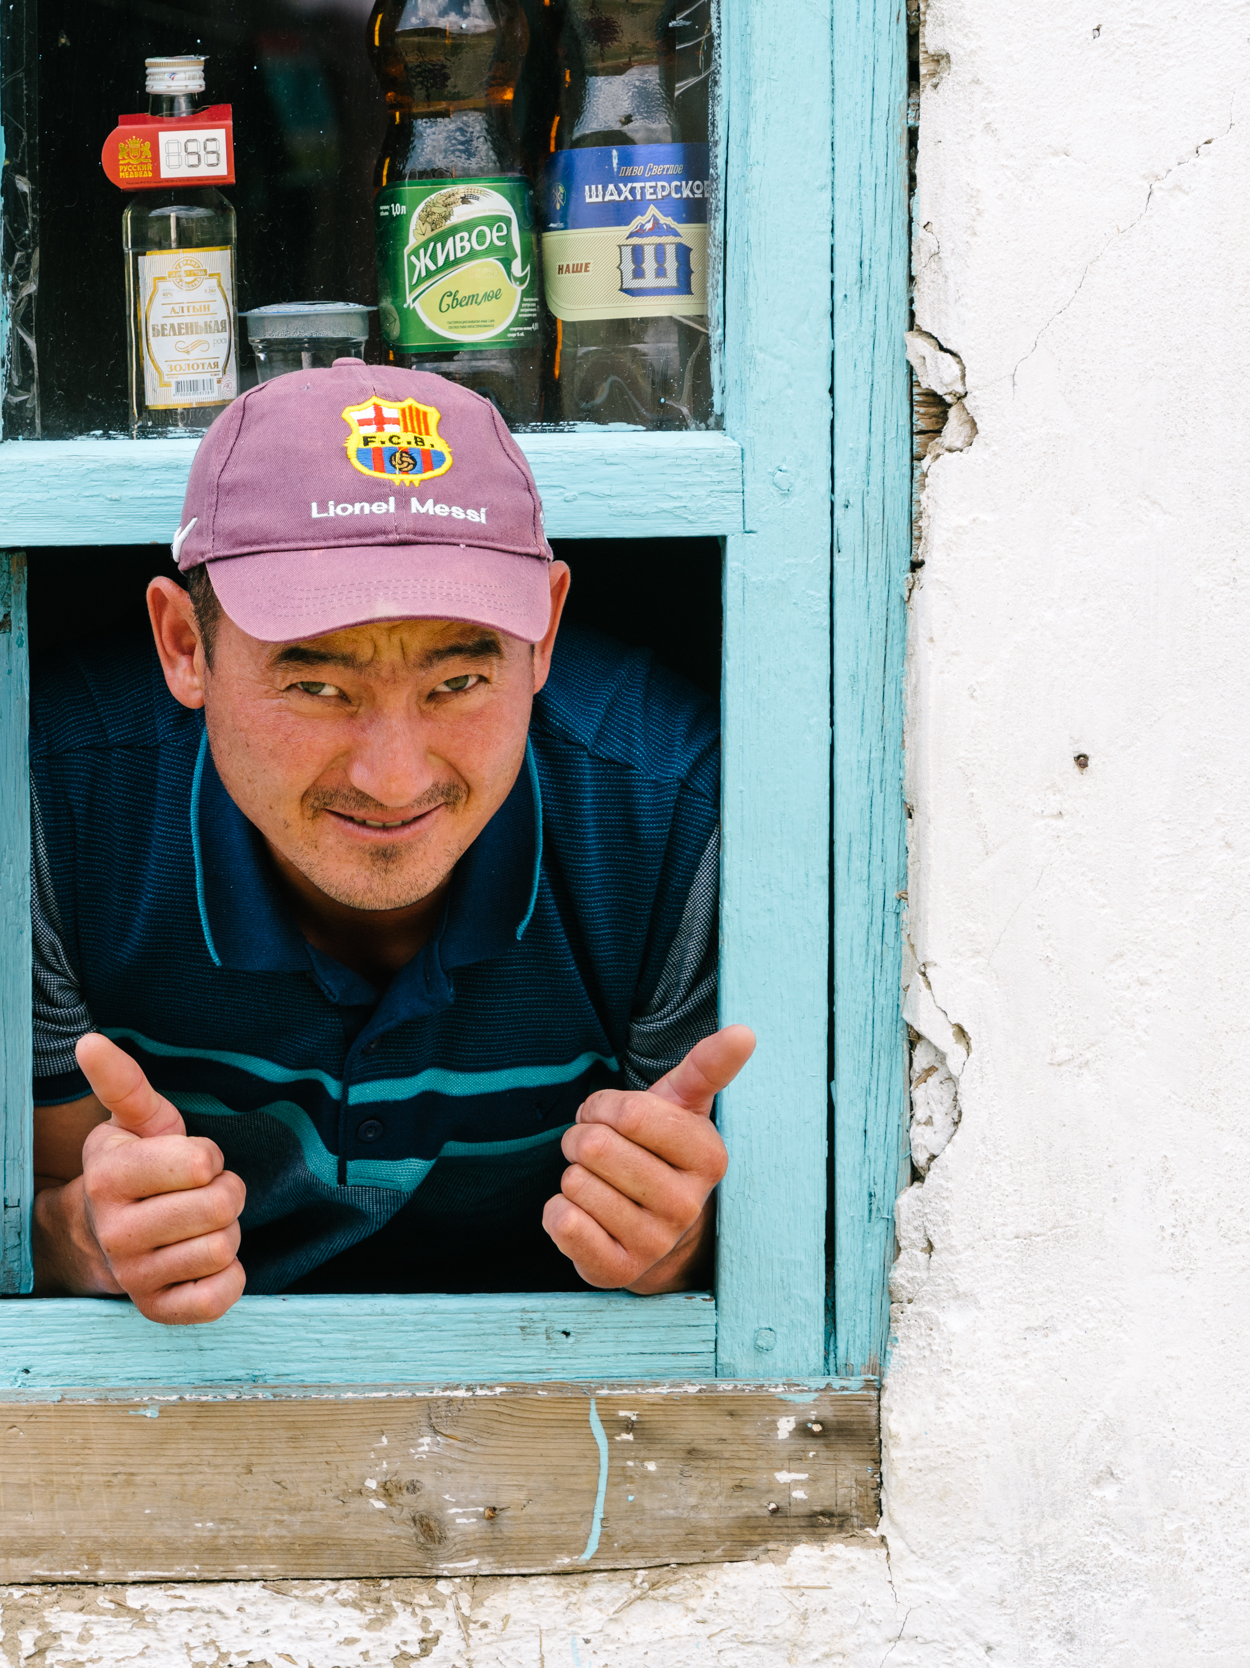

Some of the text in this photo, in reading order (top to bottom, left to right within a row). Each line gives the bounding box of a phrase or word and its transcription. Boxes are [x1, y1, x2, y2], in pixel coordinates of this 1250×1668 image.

[645, 164, 684, 178] Светлое
[558, 262, 591, 275] НАШЕ
[438, 288, 502, 313] Светлое
[170, 304, 211, 315] АЛТЫН
[152, 319, 228, 338] БЕЛЕНЬКАЯ
[167, 361, 220, 372] ЗОЛОТАЯ
[362, 434, 435, 448] F.C.B.
[311, 496, 487, 524] Lionel Messi
